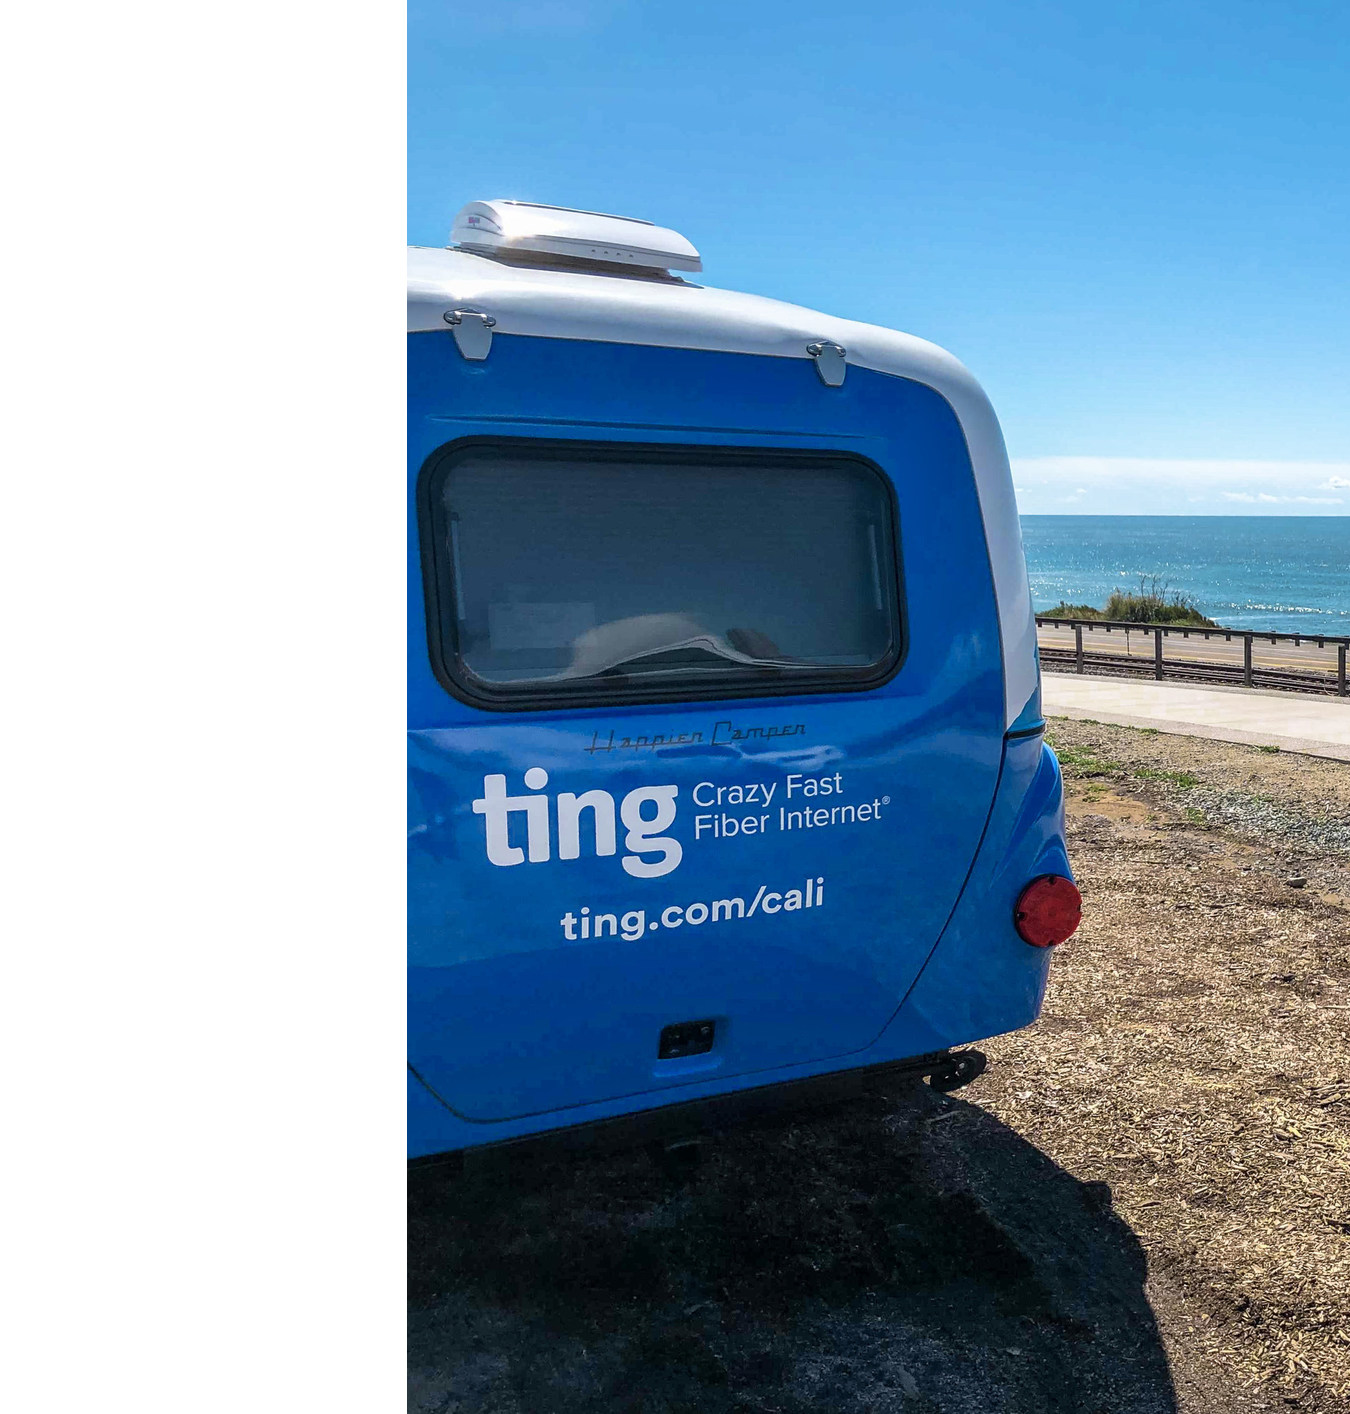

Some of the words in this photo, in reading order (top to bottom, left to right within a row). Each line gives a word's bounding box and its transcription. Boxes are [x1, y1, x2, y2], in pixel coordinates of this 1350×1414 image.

[584, 729, 704, 755] Happier
[711, 720, 806, 747] Camper
[692, 782, 777, 808] Crazy
[786, 772, 844, 799] Fast
[472, 767, 683, 879] ting
[695, 813, 770, 840] Fiber
[560, 876, 825, 941] ting.com/cali
